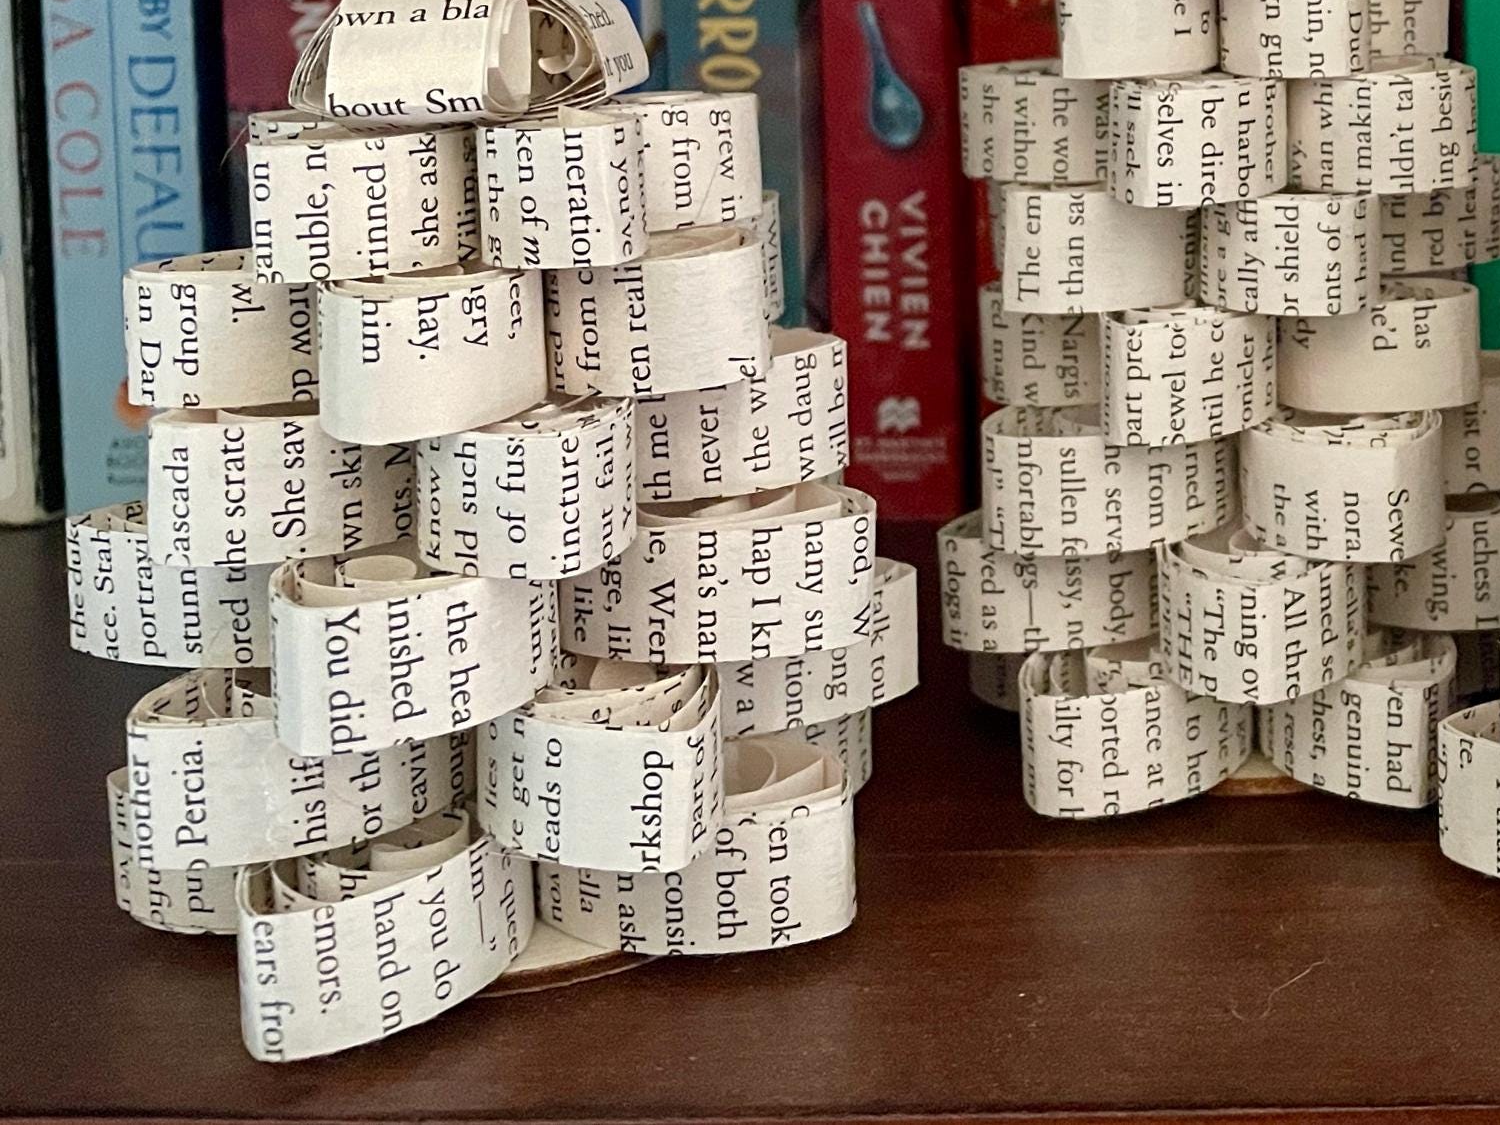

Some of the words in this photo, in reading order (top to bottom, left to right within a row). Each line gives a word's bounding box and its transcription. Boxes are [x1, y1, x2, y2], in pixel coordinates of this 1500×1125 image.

[409, 6, 427, 23] a
[1053, 88, 1078, 135] the
[1157, 91, 1184, 168] selves
[1200, 97, 1225, 131] be
[53, 82, 106, 259] COLE
[672, 137, 701, 210] from
[709, 109, 735, 181] grew
[252, 161, 272, 204] on
[520, 198, 549, 232] of
[721, 195, 744, 223] in
[411, 196, 440, 248] she
[1274, 204, 1301, 284] shield
[1316, 222, 1343, 258] of
[861, 199, 892, 343] CHIEN
[900, 190, 932, 351] VIVIEN
[1017, 239, 1042, 303] The
[1058, 238, 1086, 307] than
[171, 283, 200, 376] group
[408, 293, 450, 362] hay.
[576, 296, 601, 372] from
[1412, 301, 1438, 350] has
[700, 405, 723, 483] never
[744, 425, 770, 472] the
[271, 475, 307, 539] She
[454, 441, 478, 514] such
[551, 434, 581, 574] tincture
[1058, 446, 1088, 527] sullen
[496, 507, 527, 544] of
[1304, 490, 1329, 551] with
[1343, 490, 1363, 560] nora.
[1283, 588, 1308, 627] All
[324, 608, 362, 678] You
[543, 737, 563, 768] to
[1057, 759, 1084, 798] for
[1386, 741, 1413, 794] had
[173, 739, 208, 847] Percia.
[715, 827, 748, 861] of
[418, 893, 449, 952] you
[715, 867, 749, 940] both
[769, 874, 802, 944] took
[372, 892, 411, 983] hand
[432, 961, 460, 1001] do
